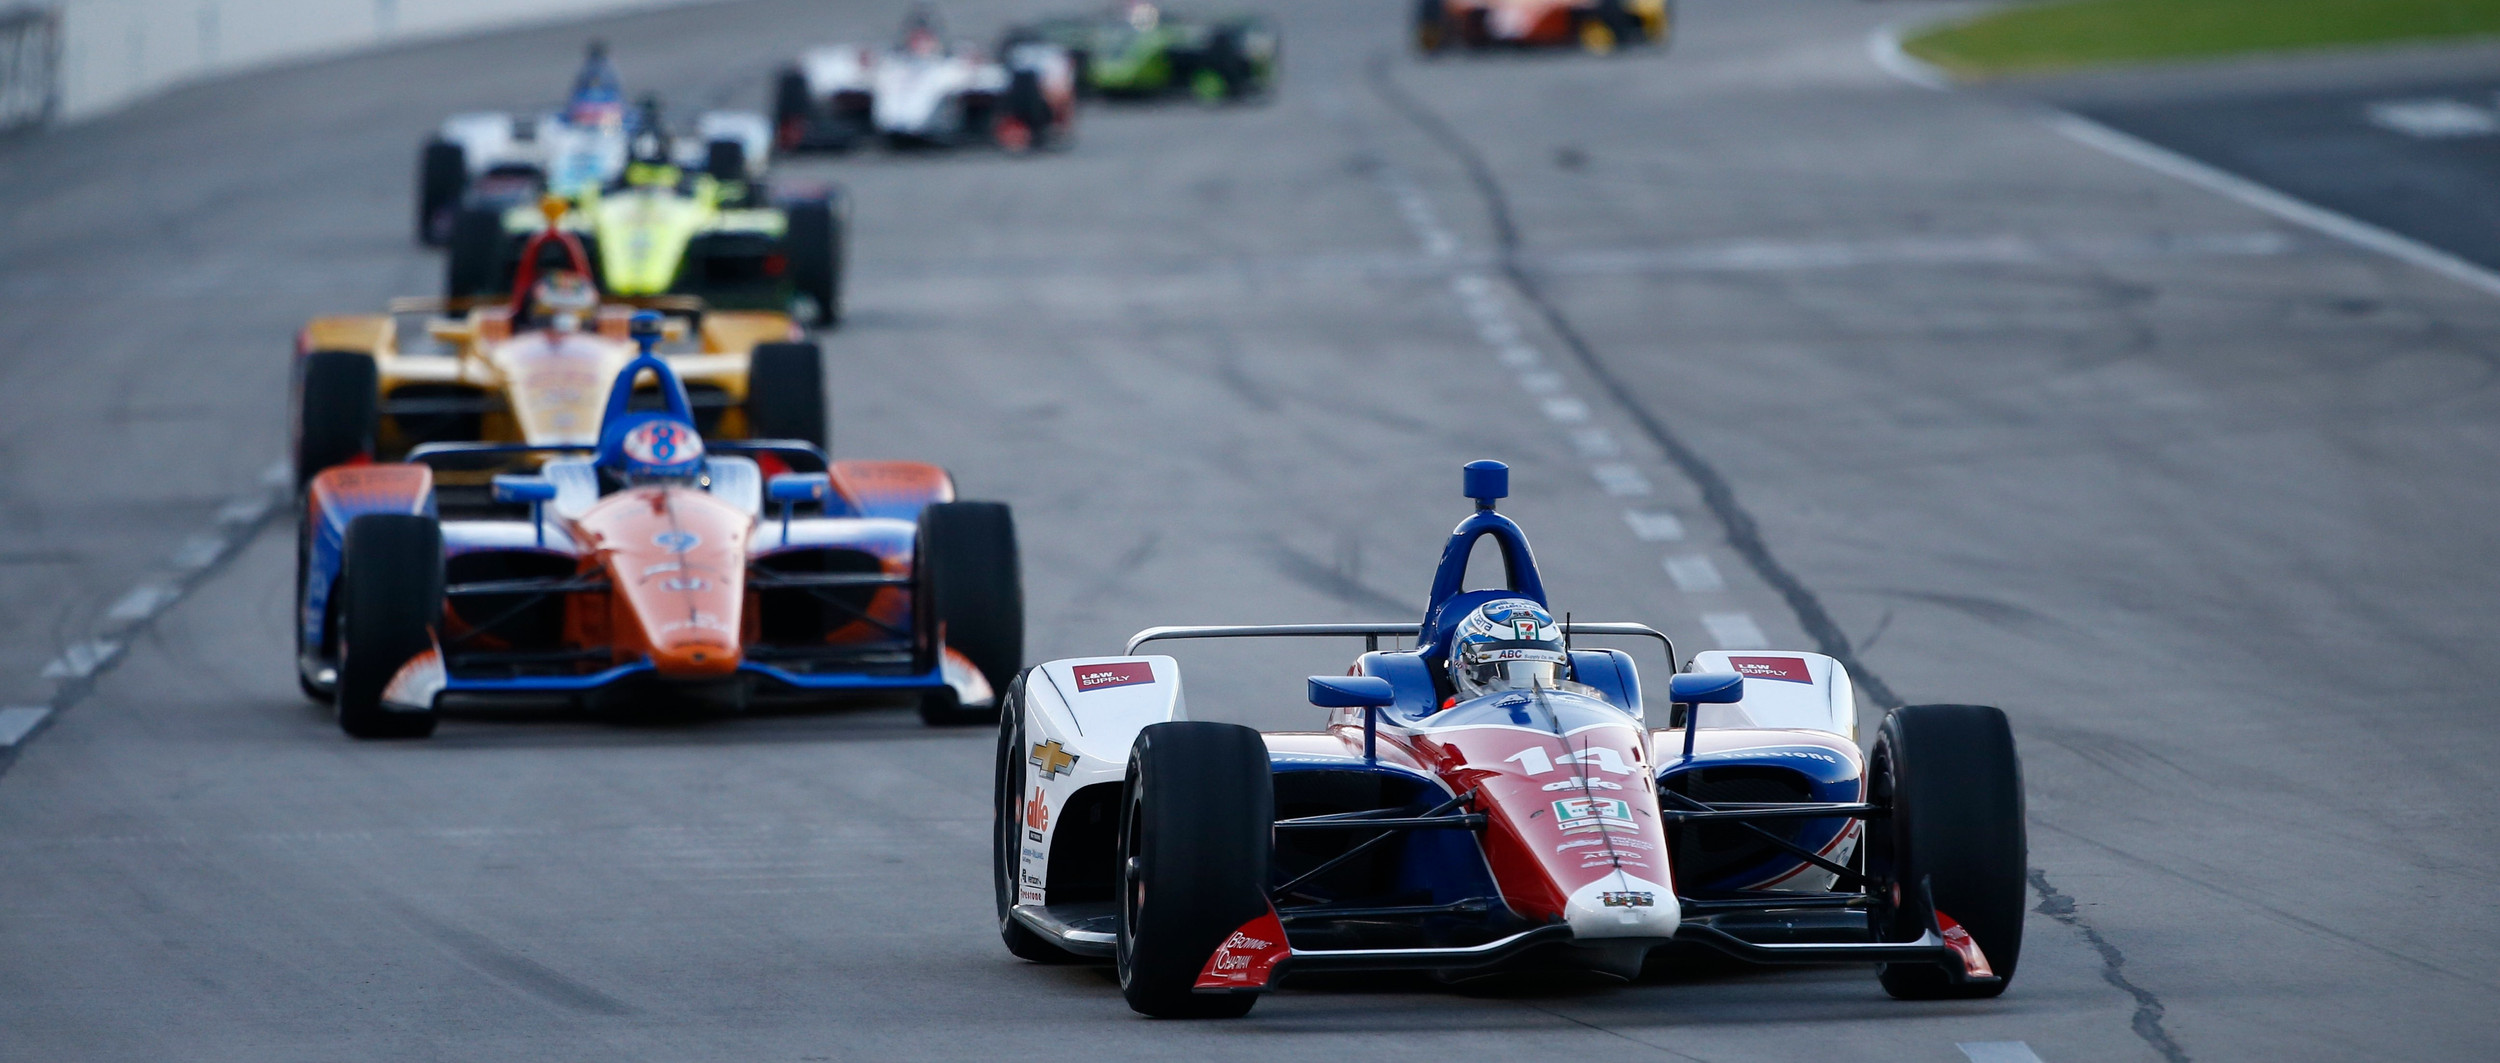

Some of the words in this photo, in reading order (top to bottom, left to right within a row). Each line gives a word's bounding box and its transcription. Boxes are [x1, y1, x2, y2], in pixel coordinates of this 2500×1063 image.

[1499, 649, 1522, 659] ABC
[1081, 671, 1113, 680] L&W
[1741, 668, 1787, 677] SUPPLY
[1083, 675, 1130, 686] SUPPLY
[1504, 746, 1637, 776] 14
[1719, 750, 1837, 764] Firestone
[1027, 786, 1049, 832] alfe
